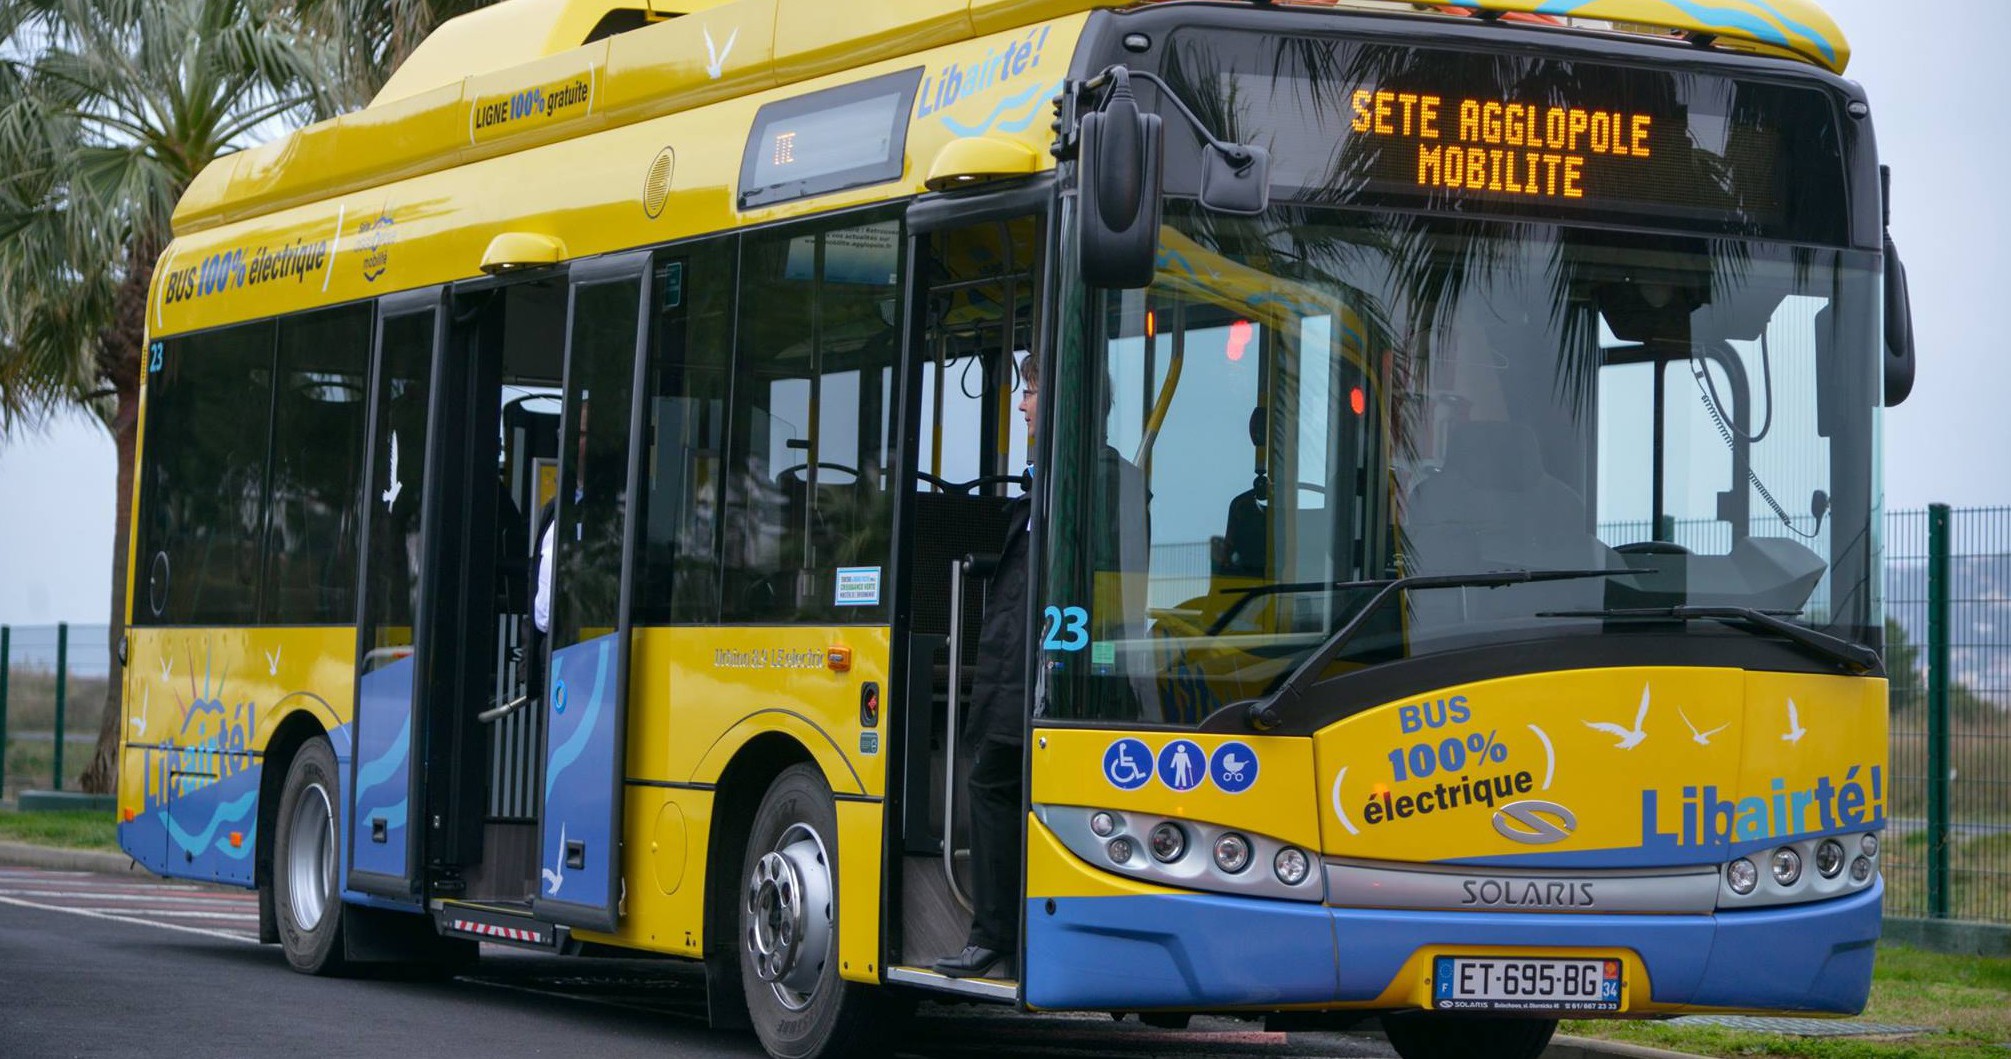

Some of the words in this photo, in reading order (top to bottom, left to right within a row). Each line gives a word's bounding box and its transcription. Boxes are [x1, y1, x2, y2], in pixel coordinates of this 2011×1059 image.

[917, 25, 1051, 119] Libairté!
[476, 101, 508, 129] LIGNE
[510, 87, 545, 120] 100%
[547, 81, 588, 117] gratuite
[1351, 89, 1440, 139] SETE
[1459, 99, 1651, 157] AGGLOPOLE
[1417, 143, 1584, 198] MOBILITE
[165, 266, 197, 304] BUS
[197, 246, 249, 297] 100%
[249, 238, 327, 284] électrique
[150, 342, 165, 373] 23
[1043, 605, 1089, 652] 23
[1398, 695, 1471, 734] BUS
[1388, 729, 1508, 782] 100%
[1363, 771, 1533, 824] électrique
[1642, 765, 1883, 847] Libairté!
[1461, 879, 1595, 907] SOLARIS
[1441, 983, 1449, 993] F
[1459, 962, 1598, 996] ET-695-BG
[1602, 981, 1618, 997] 34
